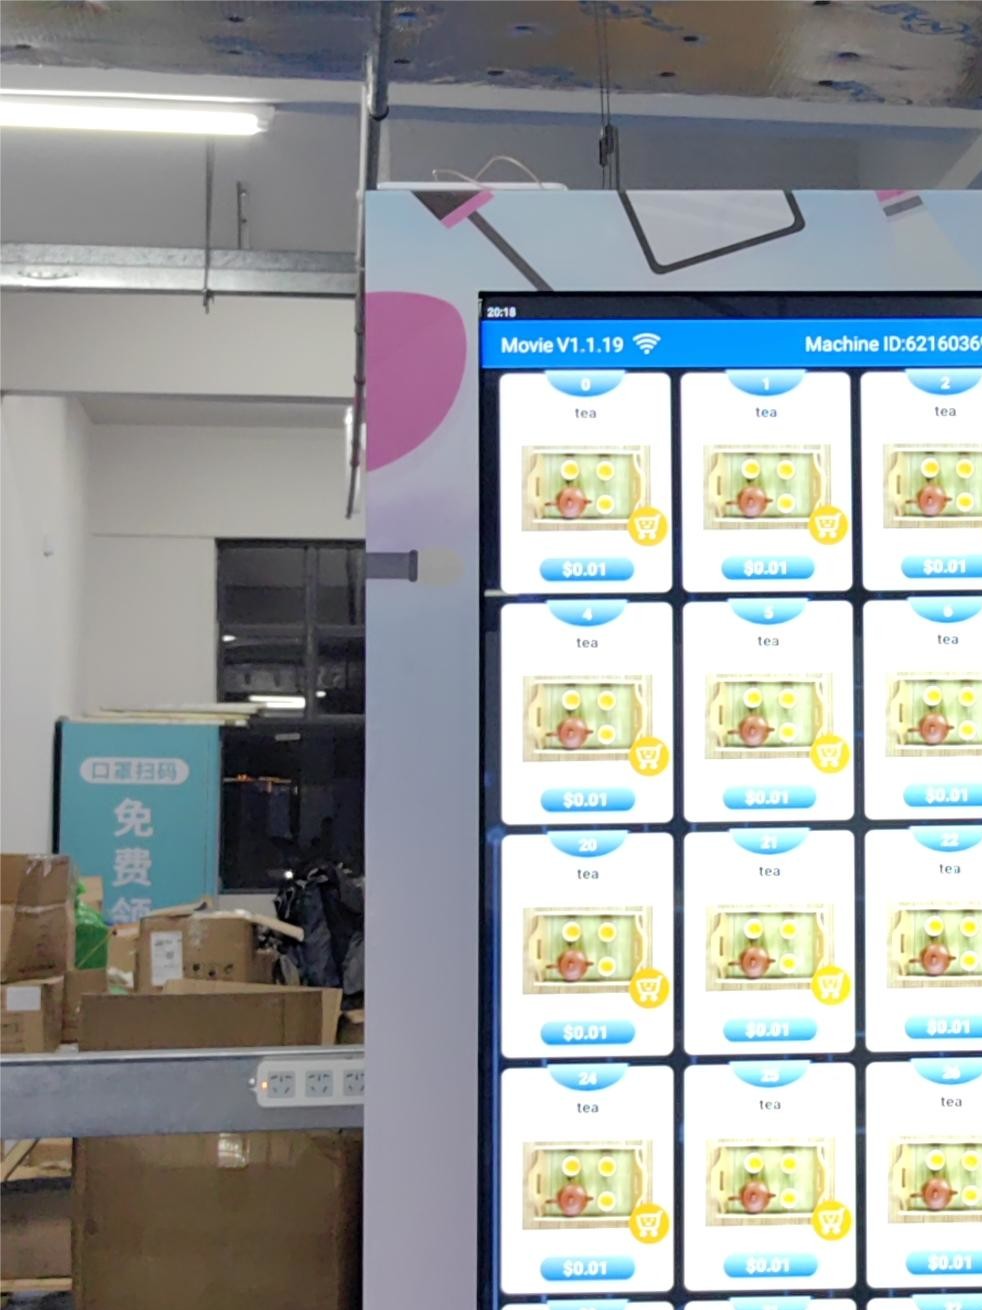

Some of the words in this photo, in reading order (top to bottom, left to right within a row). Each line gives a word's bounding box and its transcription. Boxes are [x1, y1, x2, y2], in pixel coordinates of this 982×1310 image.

[487, 307, 516, 318] 20:18
[501, 337, 554, 353] Movie
[556, 337, 624, 353] V1.1.19
[805, 336, 880, 352] Machine
[580, 378, 591, 391] 0
[762, 378, 770, 390] 1
[940, 377, 951, 390] 2
[575, 408, 596, 419] tea
[756, 407, 777, 418] tea
[935, 406, 956, 417] tea
[562, 560, 606, 578] $0.01
[744, 559, 787, 576] $0.01
[923, 557, 966, 574] $0.01
[582, 608, 592, 620] 4
[763, 605, 774, 618] 5
[943, 605, 953, 618] 6
[577, 637, 598, 648] tea
[758, 636, 779, 647] tea
[938, 634, 958, 645] tea
[91, 761, 177, 780] 口罩扫码
[564, 792, 607, 808] $0.01
[745, 788, 788, 806] $0.01
[926, 786, 968, 803] $0.01
[579, 838, 597, 852] 20
[760, 836, 777, 849] 21
[940, 834, 959, 847] 22
[577, 869, 598, 880] tea
[760, 866, 780, 877] tea
[940, 863, 960, 874] tea
[564, 1024, 607, 1041] $0.01
[746, 1022, 789, 1039] $0.01
[928, 1018, 970, 1036] $0.01
[578, 1072, 597, 1086] 24
[760, 1100, 780, 1110] tea
[941, 1096, 962, 1107] tea
[577, 1103, 598, 1114] tea
[564, 1260, 607, 1277] $0.01
[746, 1257, 789, 1274] $0.01
[928, 1254, 972, 1271] $0.01
